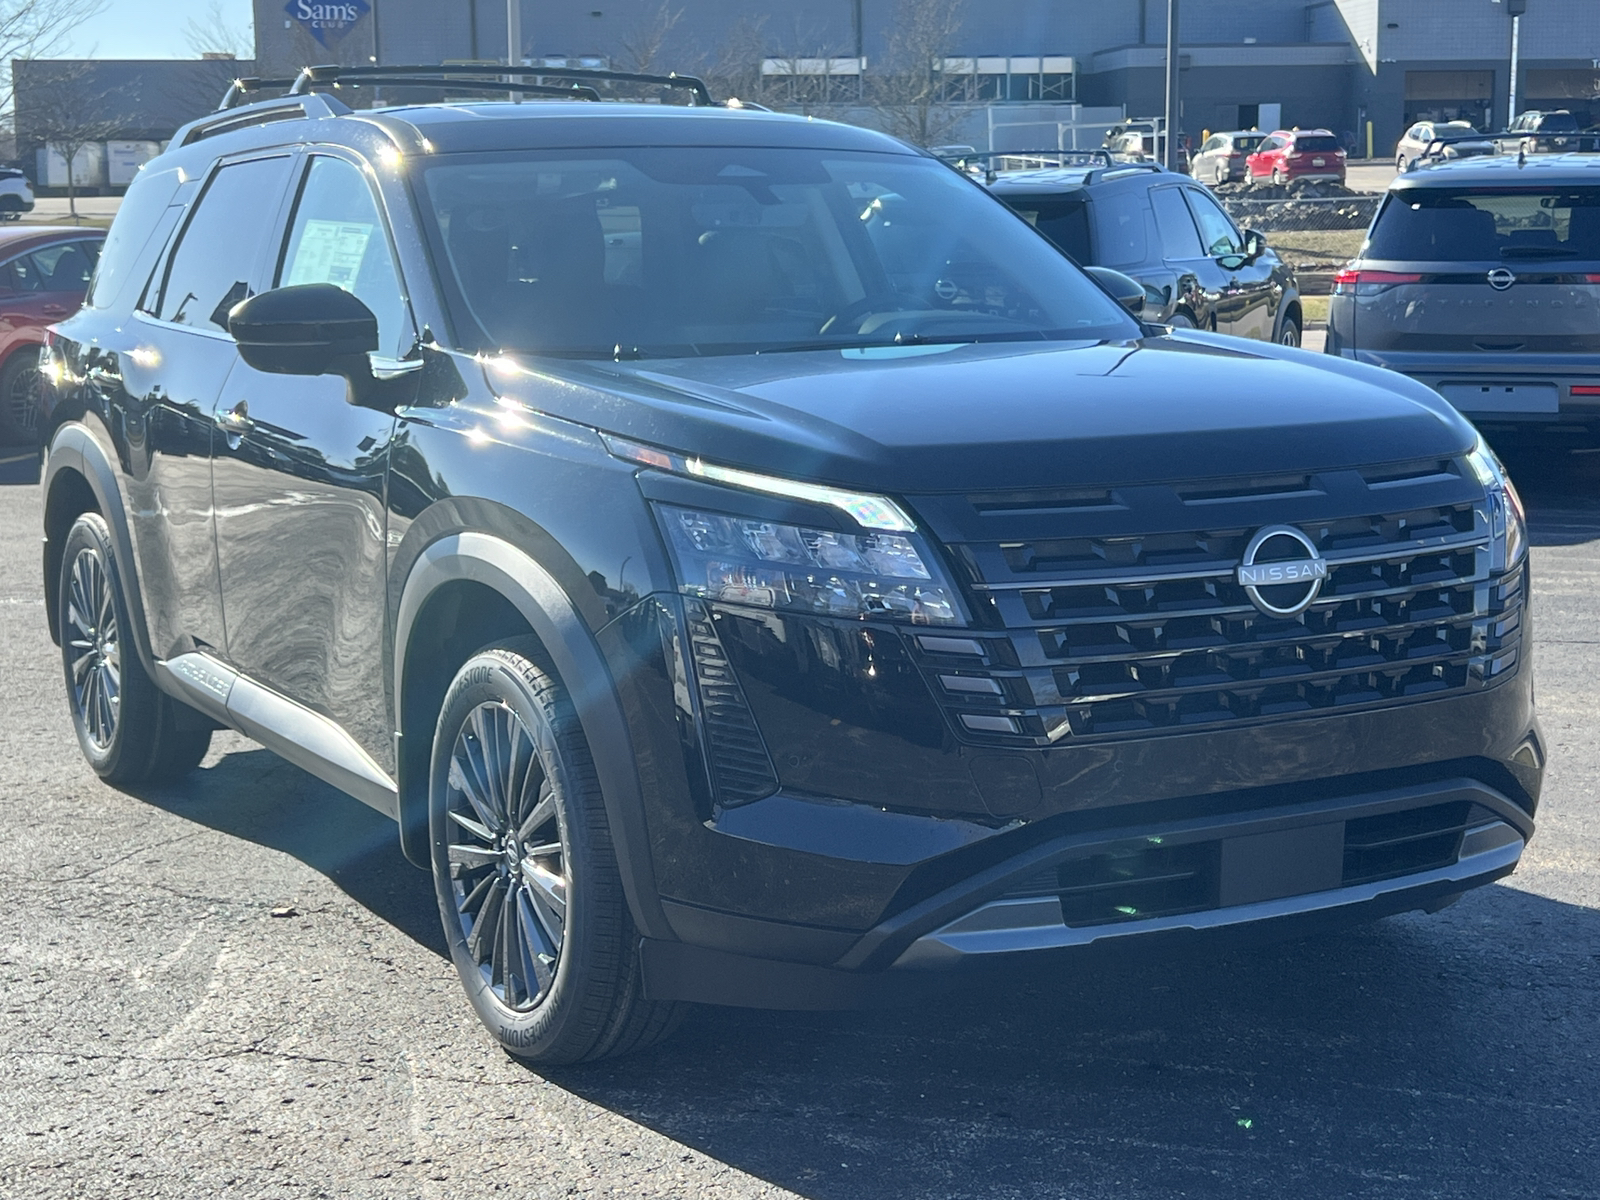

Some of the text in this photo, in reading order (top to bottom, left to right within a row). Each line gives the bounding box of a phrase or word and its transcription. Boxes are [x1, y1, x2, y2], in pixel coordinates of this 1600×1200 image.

[297, 0, 358, 21] Sam's
[311, 20, 345, 29] CLUB
[1241, 562, 1325, 582] NISSAN
